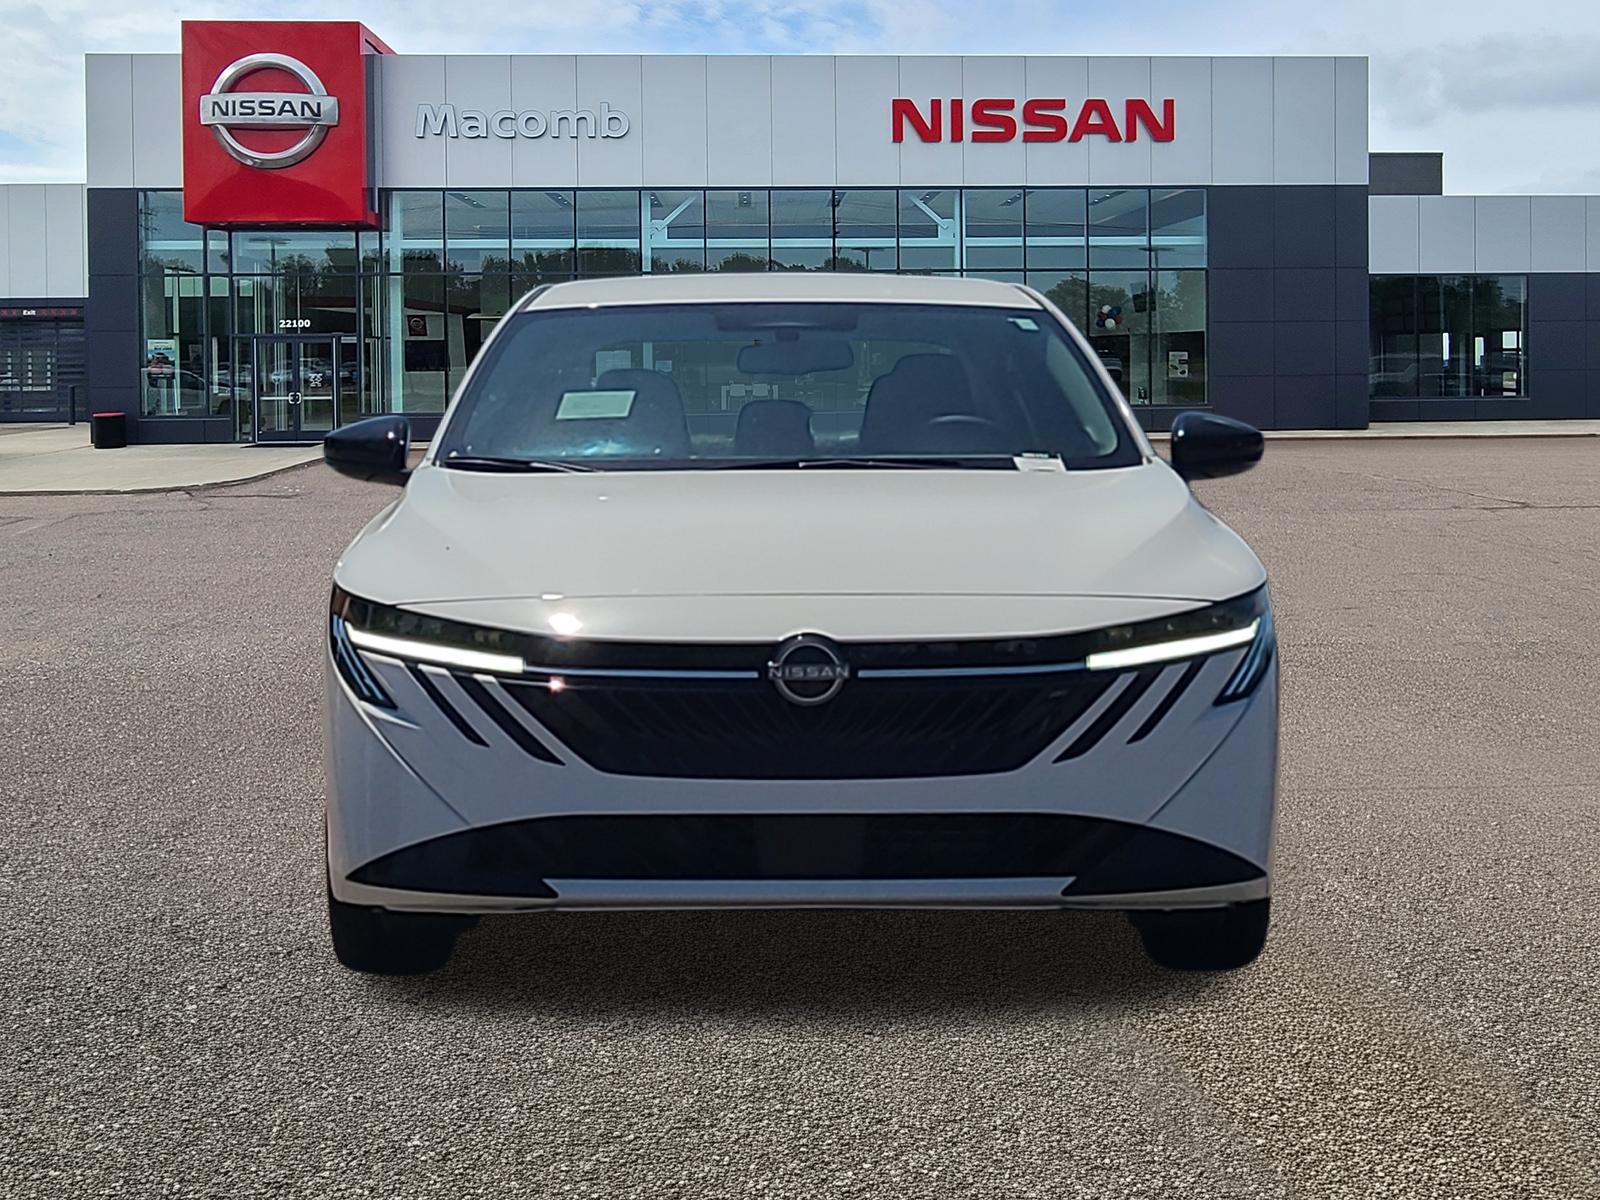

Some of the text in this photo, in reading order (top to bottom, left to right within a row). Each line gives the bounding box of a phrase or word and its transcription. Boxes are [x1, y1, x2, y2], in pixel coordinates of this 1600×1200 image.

[210, 98, 323, 118] NISSAN
[415, 102, 630, 139] Macomb
[892, 98, 1176, 143] NISSAN
[279, 319, 311, 328] 22100
[768, 665, 850, 678] NISSAN
